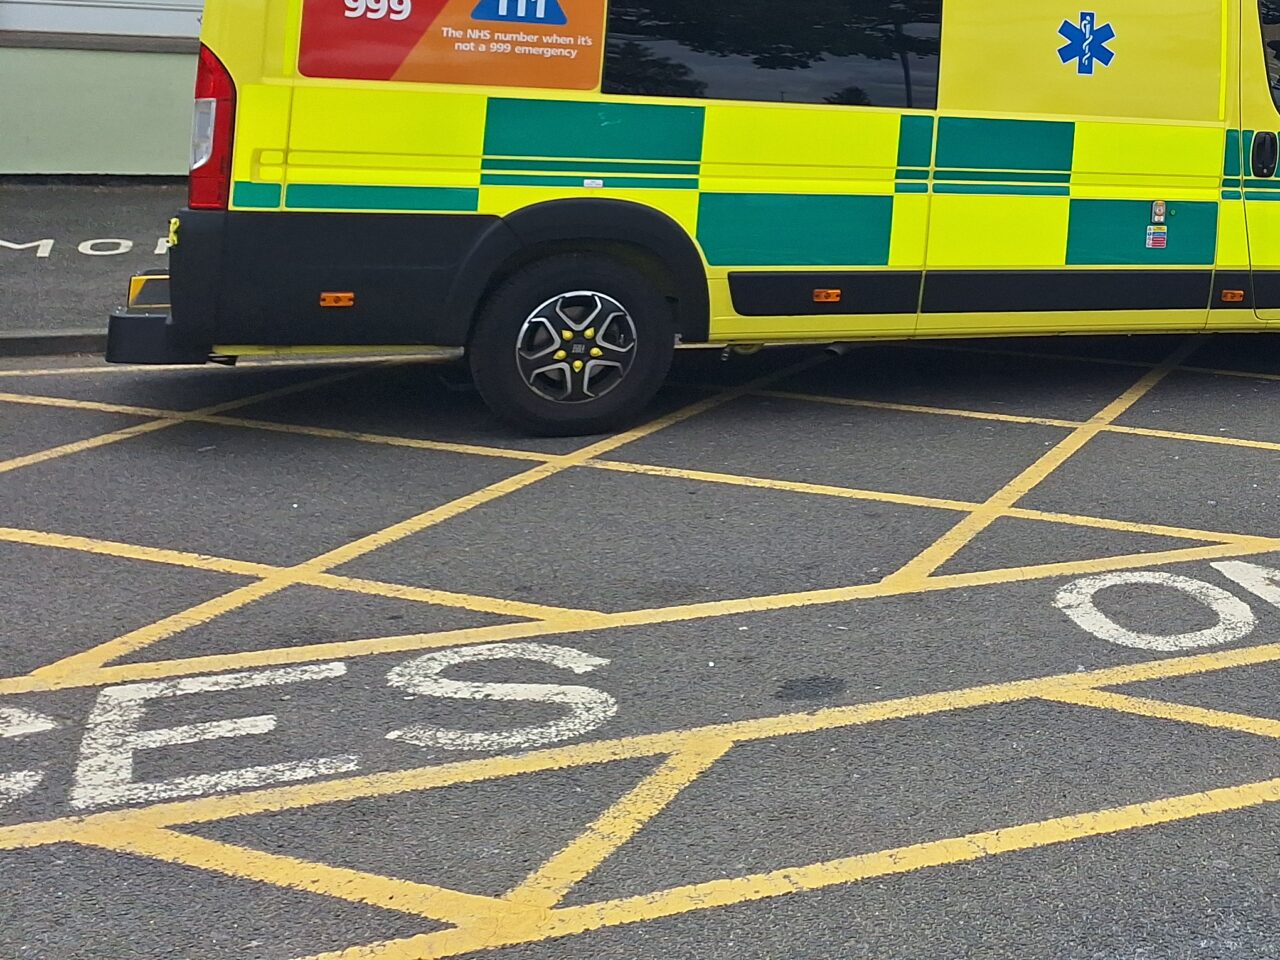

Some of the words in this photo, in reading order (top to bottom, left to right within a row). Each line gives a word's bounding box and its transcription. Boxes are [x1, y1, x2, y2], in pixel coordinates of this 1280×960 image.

[441, 27, 463, 39] The
[467, 28, 491, 40] NHS
[494, 31, 539, 43] number
[542, 33, 574, 45] when
[577, 35, 593, 46] it's
[454, 42, 475, 52] not
[478, 43, 486, 52] a
[490, 42, 512, 53] 999
[515, 45, 578, 58] emergency
